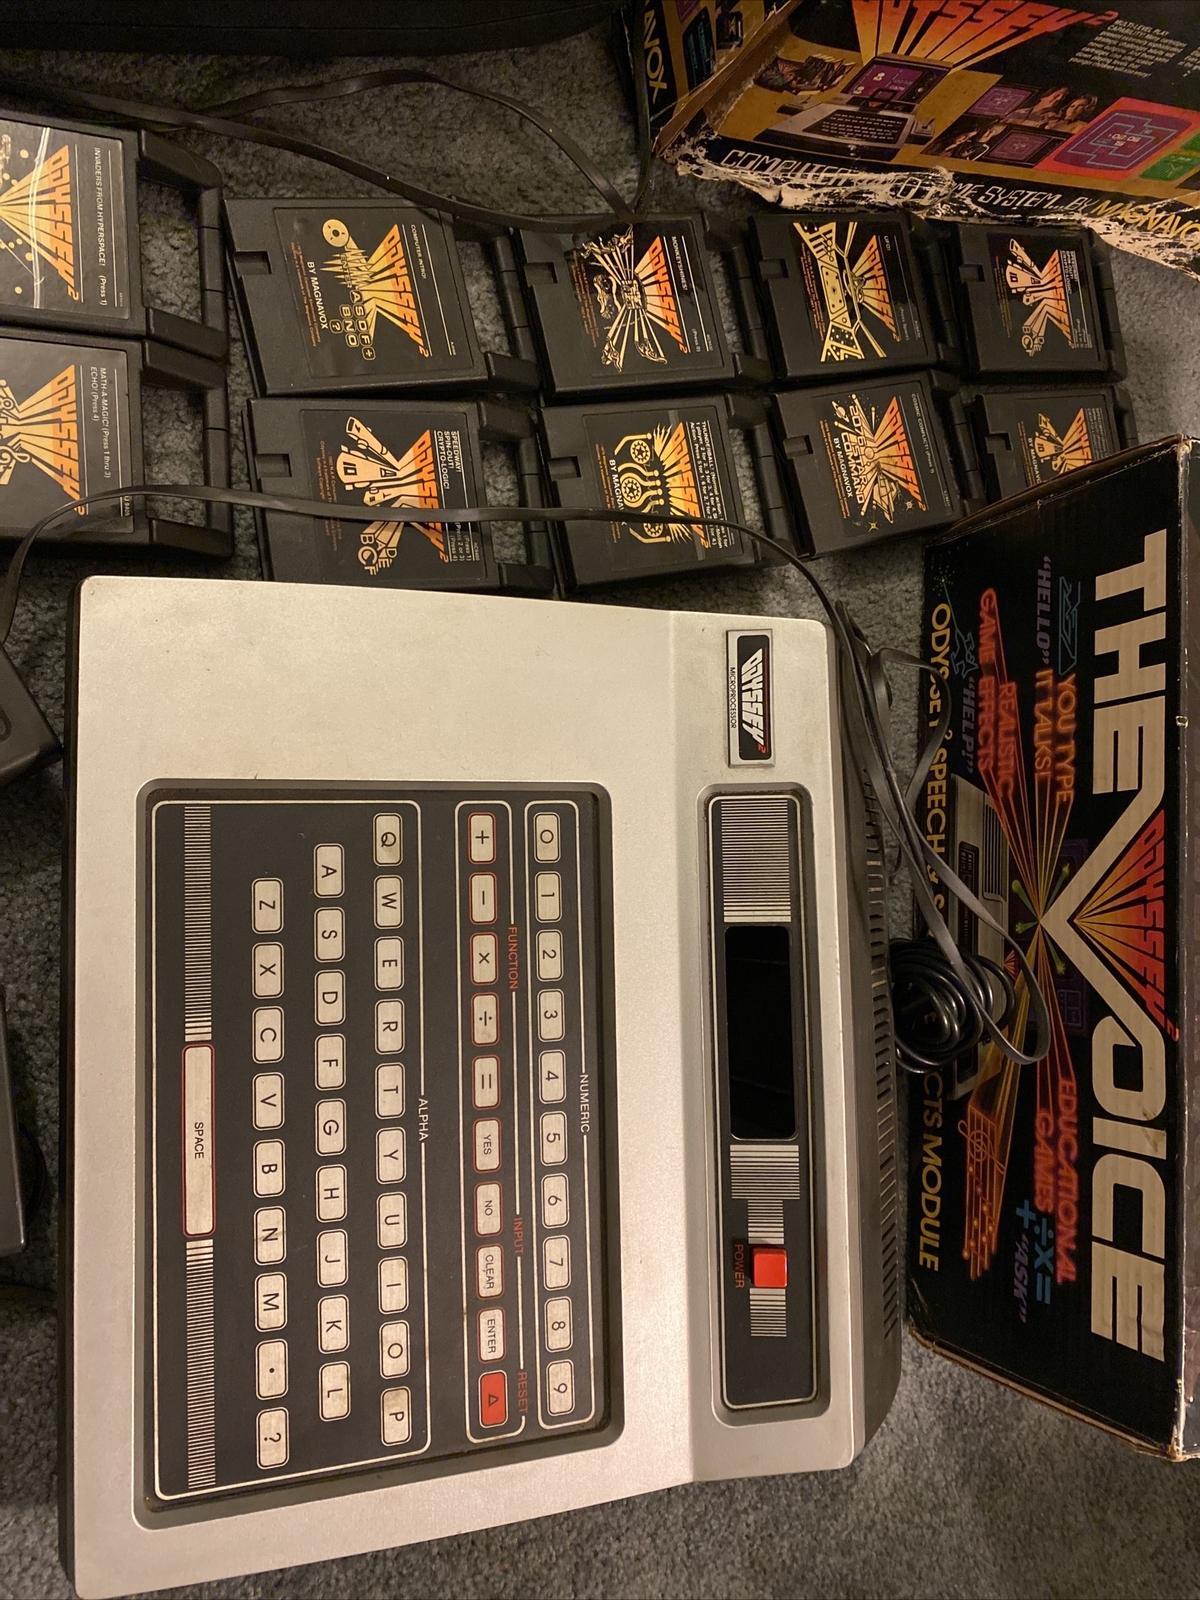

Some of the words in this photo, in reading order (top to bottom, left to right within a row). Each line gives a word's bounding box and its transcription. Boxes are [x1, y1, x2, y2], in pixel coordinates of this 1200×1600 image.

[94, 147, 103, 186] INVADERS
[95, 187, 104, 210] FROM
[1069, 196, 1095, 212] BY
[96, 211, 106, 266] HYPERSPACE!
[883, 235, 891, 251] UFO!
[411, 224, 423, 258] COMPUTER
[417, 258, 426, 279] INTRO!
[307, 261, 316, 274] BY
[671, 236, 688, 291] MONKEYSHINES!
[98, 275, 107, 298] (Press
[310, 276, 329, 329] MAGNAVOX
[90, 366, 99, 391] ECHO!
[90, 391, 99, 413] (Press
[99, 367, 109, 427] MATH-A-MAGIC!
[911, 393, 921, 417] COSMIC
[91, 413, 100, 422] 4)
[849, 405, 867, 447] 2076
[101, 428, 110, 450] (Press
[443, 430, 454, 469] SPIN-OUT!
[701, 421, 714, 471] THUNDERBALL!
[833, 437, 841, 449] BY
[1028, 437, 1034, 447] BY
[436, 430, 450, 489] CRYPTO-LOGIC!
[450, 430, 462, 472] SPEEDWAY!
[103, 455, 111, 470] thru
[609, 459, 617, 472] BY
[840, 432, 864, 504] COMMAND
[1030, 448, 1042, 484] MAGNAVO
[836, 451, 853, 498] MAGNAVOX
[978, 588, 997, 664] GAME
[1092, 529, 1167, 798] THE
[1035, 668, 1053, 690] IT
[729, 667, 737, 729] MICROPROCESSOR
[1056, 673, 1076, 734] YOU
[977, 675, 995, 774] EFFECTS
[997, 682, 1016, 798] REALISTIC
[1034, 698, 1053, 779] TALKS!
[1055, 746, 1075, 803] TYPE
[926, 747, 947, 854] SPEECH
[381, 831, 397, 848] Q
[321, 865, 337, 878] A
[259, 900, 276, 910] Z
[381, 892, 397, 910] W
[321, 930, 338, 939] S
[382, 959, 398, 968] E
[507, 926, 519, 990] FUNCTION
[542, 949, 557, 960] 2
[259, 963, 276, 976] X
[322, 991, 338, 1005] D
[543, 1010, 558, 1020] 3
[260, 1027, 277, 1043] C
[382, 1021, 398, 1032] R
[322, 1059, 338, 1067] F
[545, 1070, 559, 1081] 4
[260, 1093, 277, 1107] V
[383, 1085, 399, 1094] T
[579, 1074, 590, 1133] NUMERIC
[323, 1119, 339, 1136] G
[418, 1098, 429, 1141] ALPHA
[193, 1122, 204, 1160] SPACE
[483, 1134, 493, 1155] YES
[546, 1133, 561, 1143] 5
[383, 1149, 399, 1160] Y
[1033, 1108, 1055, 1214] GAMES
[261, 1163, 278, 1174] B
[1055, 1077, 1079, 1285] EDUCATIONAL
[323, 1187, 340, 1200] H
[547, 1195, 562, 1206] 6
[918, 1131, 943, 1272] MODULE
[484, 1200, 494, 1216] NO
[384, 1214, 400, 1226] U
[262, 1227, 278, 1242] N
[513, 1217, 524, 1255] INPUT
[324, 1255, 341, 1263] J
[549, 1257, 564, 1267] 7
[734, 1244, 745, 1289] POWER
[485, 1254, 495, 1289] CLEAR
[263, 1293, 279, 1311] M
[326, 1320, 342, 1333] K
[486, 1318, 497, 1354] ENTER
[551, 1321, 566, 1331] 8
[327, 1388, 343, 1398] L
[517, 1371, 528, 1414] RESET
[553, 1383, 568, 1394] 9
[389, 1411, 405, 1422] P
